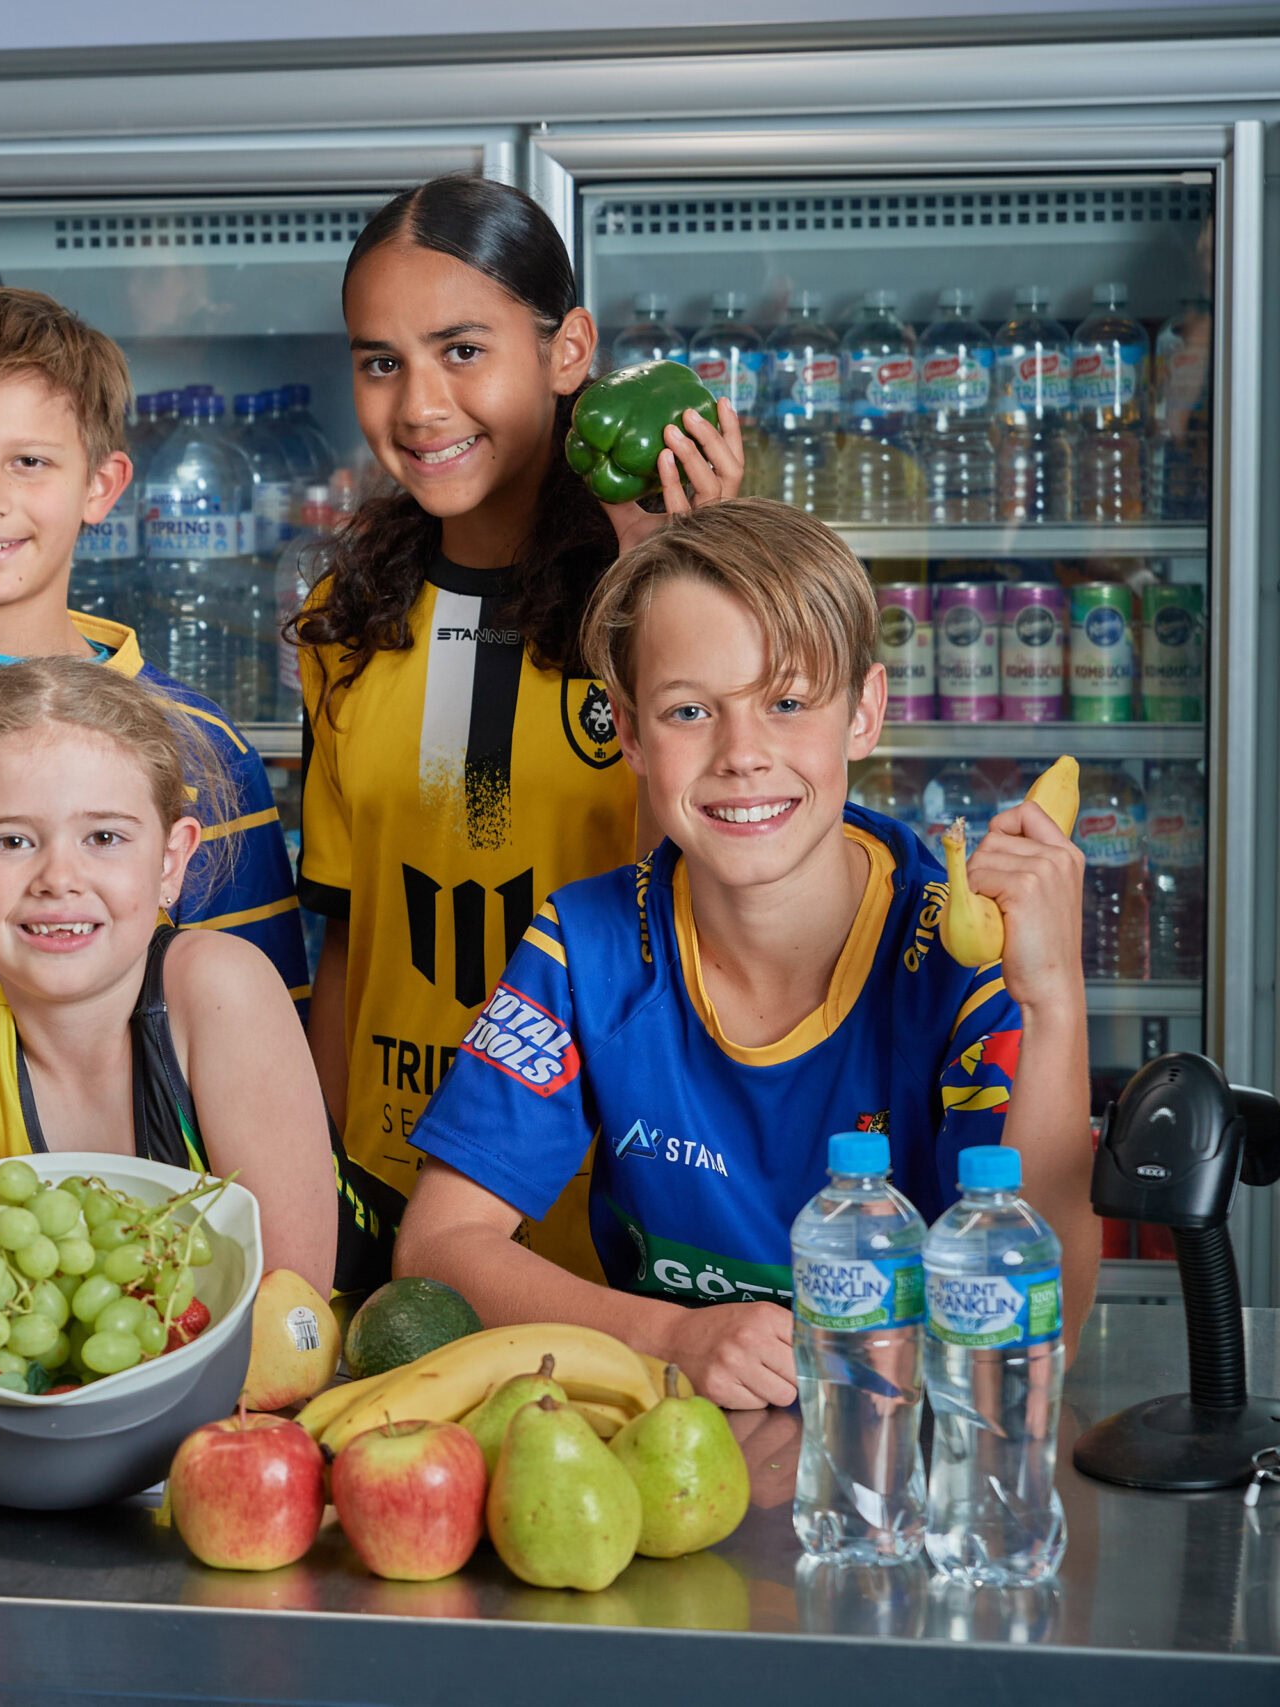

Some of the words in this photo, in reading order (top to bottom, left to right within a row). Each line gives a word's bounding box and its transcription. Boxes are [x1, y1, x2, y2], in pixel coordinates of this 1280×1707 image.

[437, 628, 519, 645] STANNO
[483, 988, 572, 1058] TOTAL
[463, 1016, 562, 1084] TOOLS
[796, 1269, 882, 1298] FRANKLIN
[808, 1264, 864, 1280] MOUNT
[928, 1285, 1017, 1315] FRANKLIN
[940, 1281, 997, 1297] MOUNT
